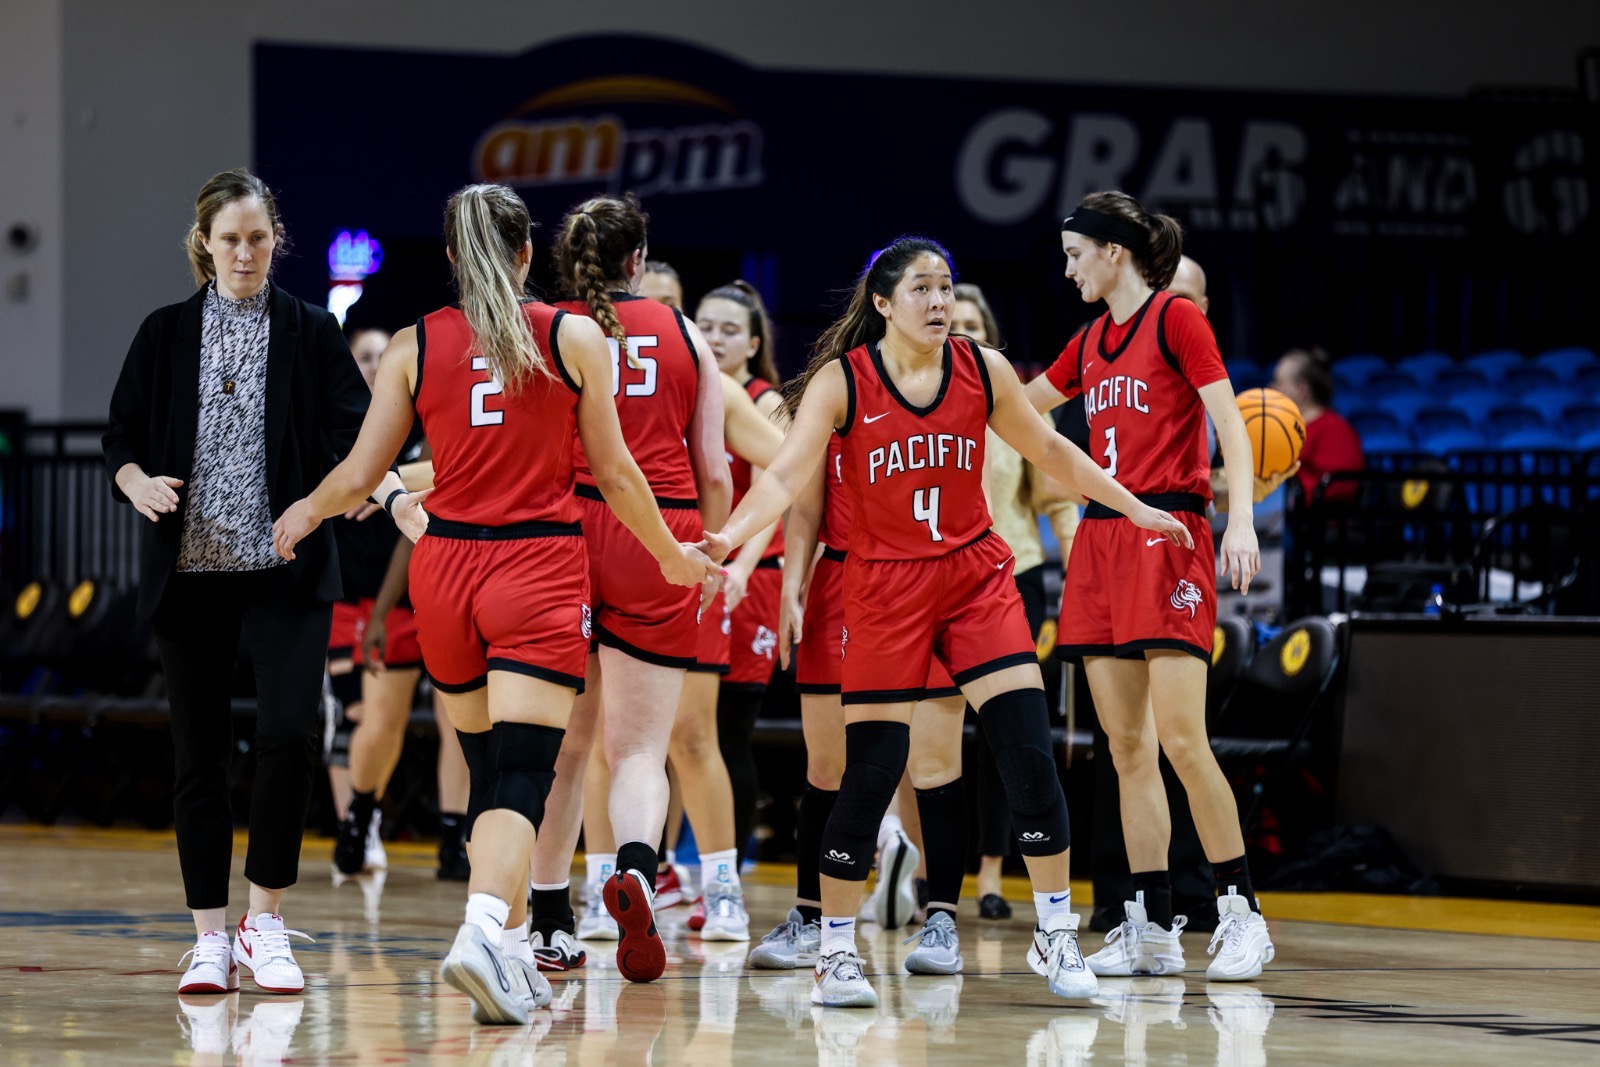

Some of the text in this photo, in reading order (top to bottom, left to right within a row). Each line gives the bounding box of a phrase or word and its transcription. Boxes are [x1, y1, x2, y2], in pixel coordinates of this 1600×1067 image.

[474, 116, 764, 198] ampm
[954, 106, 1307, 230] GRAB
[470, 355, 505, 428] 2
[868, 432, 976, 485] PACIFIC
[1102, 425, 1118, 477] 3
[912, 485, 944, 542] 4
